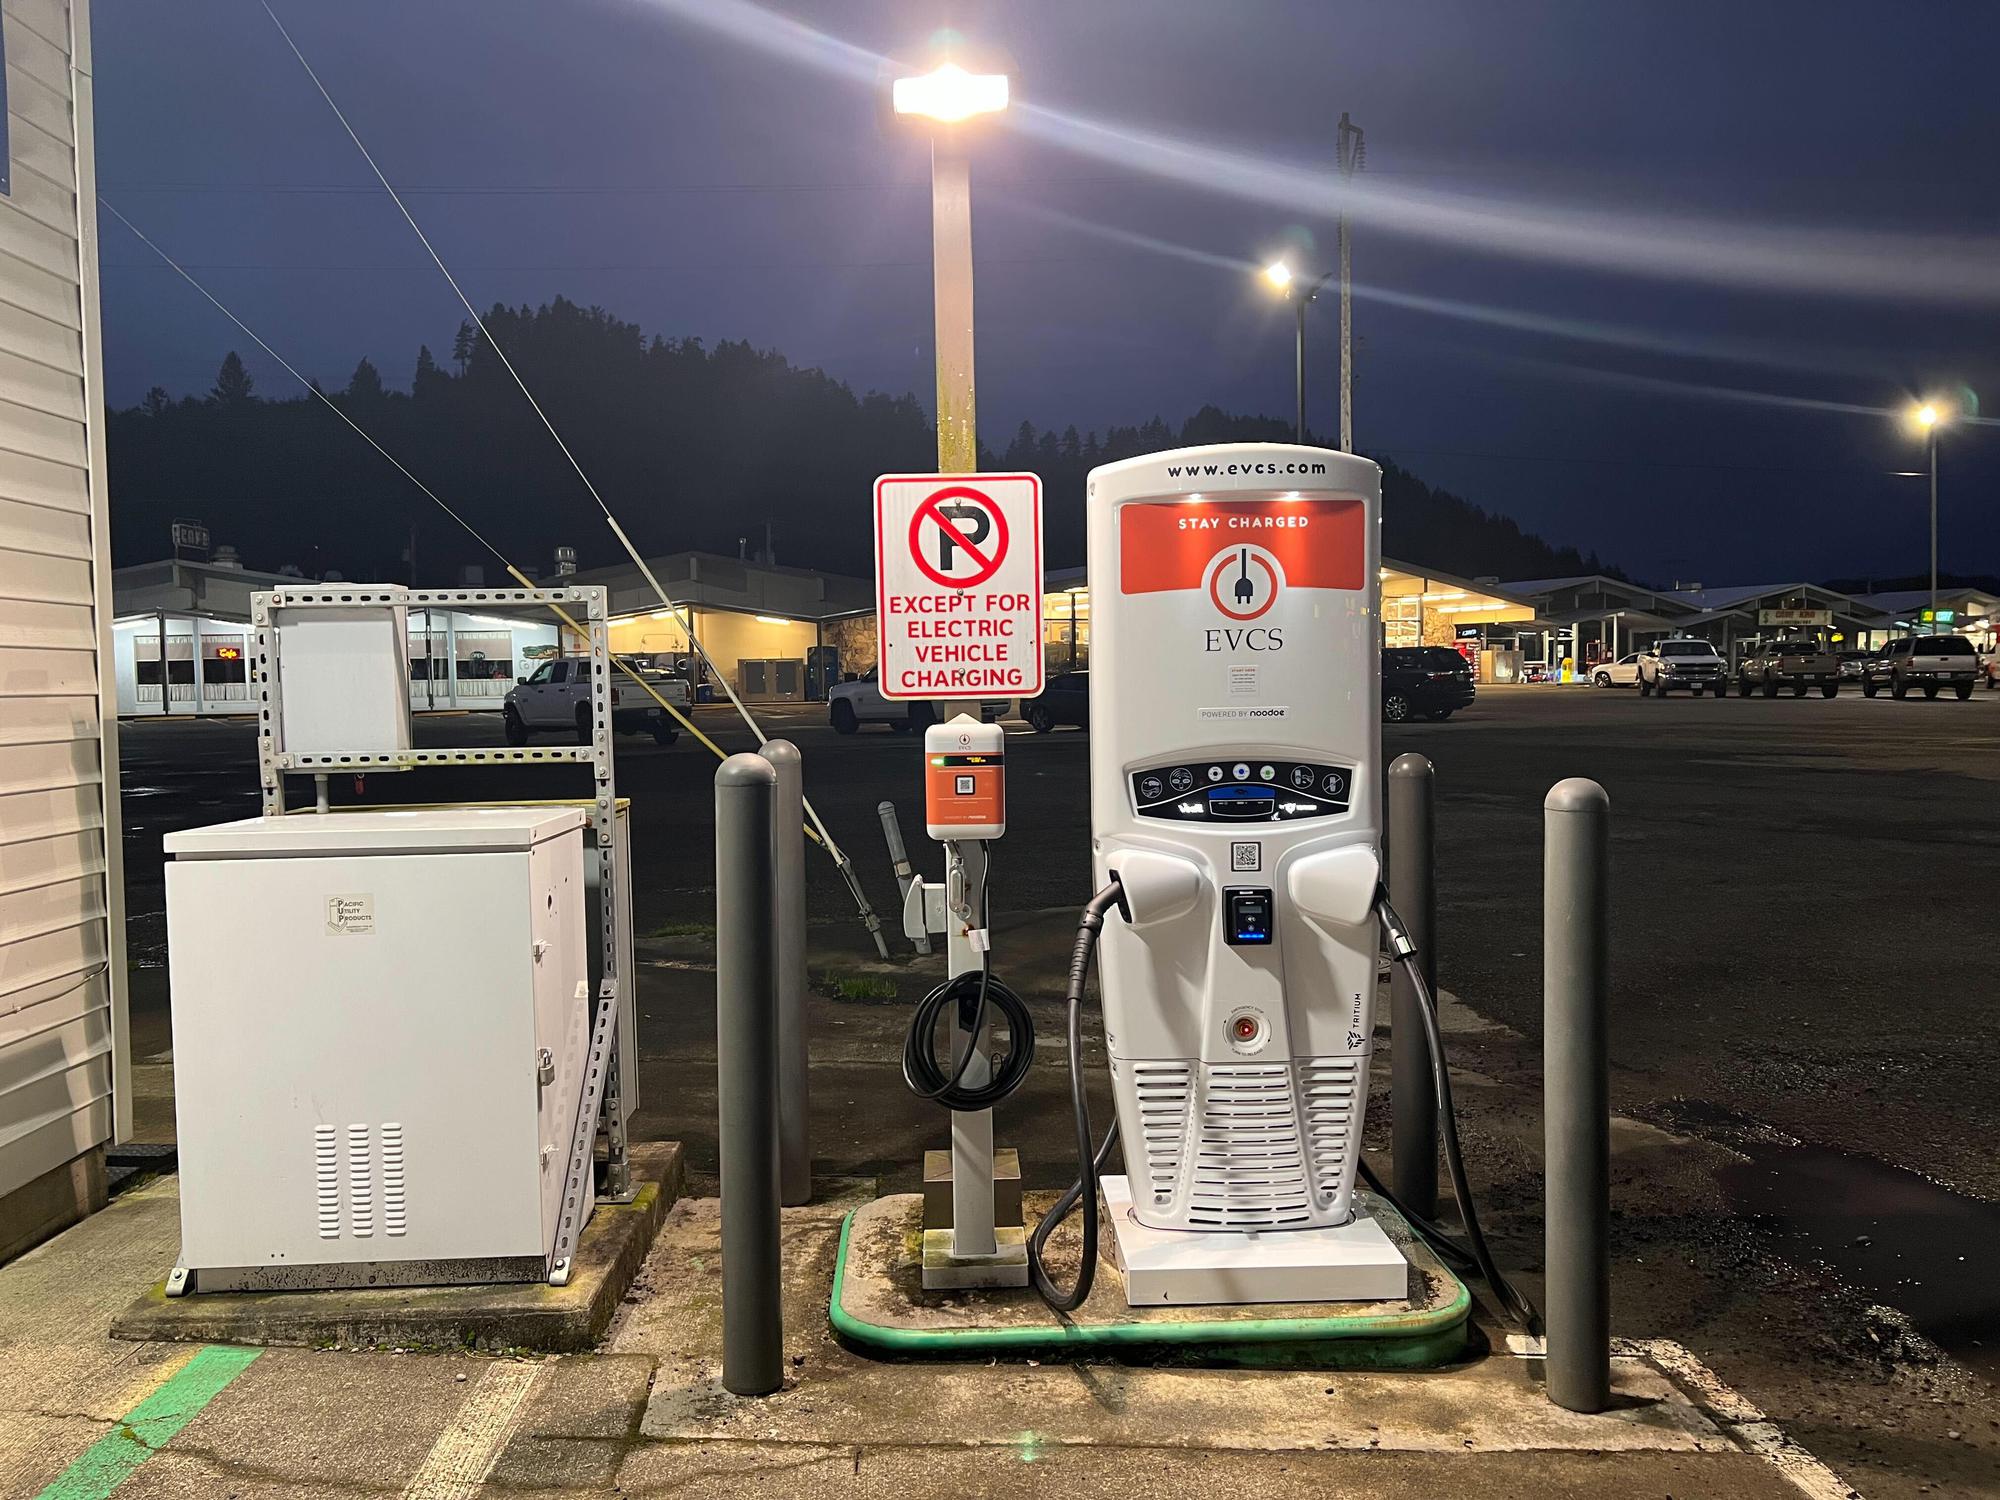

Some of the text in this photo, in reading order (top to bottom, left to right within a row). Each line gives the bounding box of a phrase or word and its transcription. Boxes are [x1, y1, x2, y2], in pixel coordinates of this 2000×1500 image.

[1168, 462, 1326, 478] www.evcs.com
[1178, 516, 1309, 530] STAY CHARGED
[889, 594, 1030, 614] EXCEPT FOR
[907, 619, 1014, 638] ELECTRIC
[1203, 628, 1284, 652] EVCS
[915, 643, 1008, 663] VEHICLE
[901, 668, 1023, 688] CHARGING
[1201, 710, 1237, 718] POWERED
[1249, 709, 1285, 717] noodoe
[1352, 993, 1361, 1029] TRITIUM
